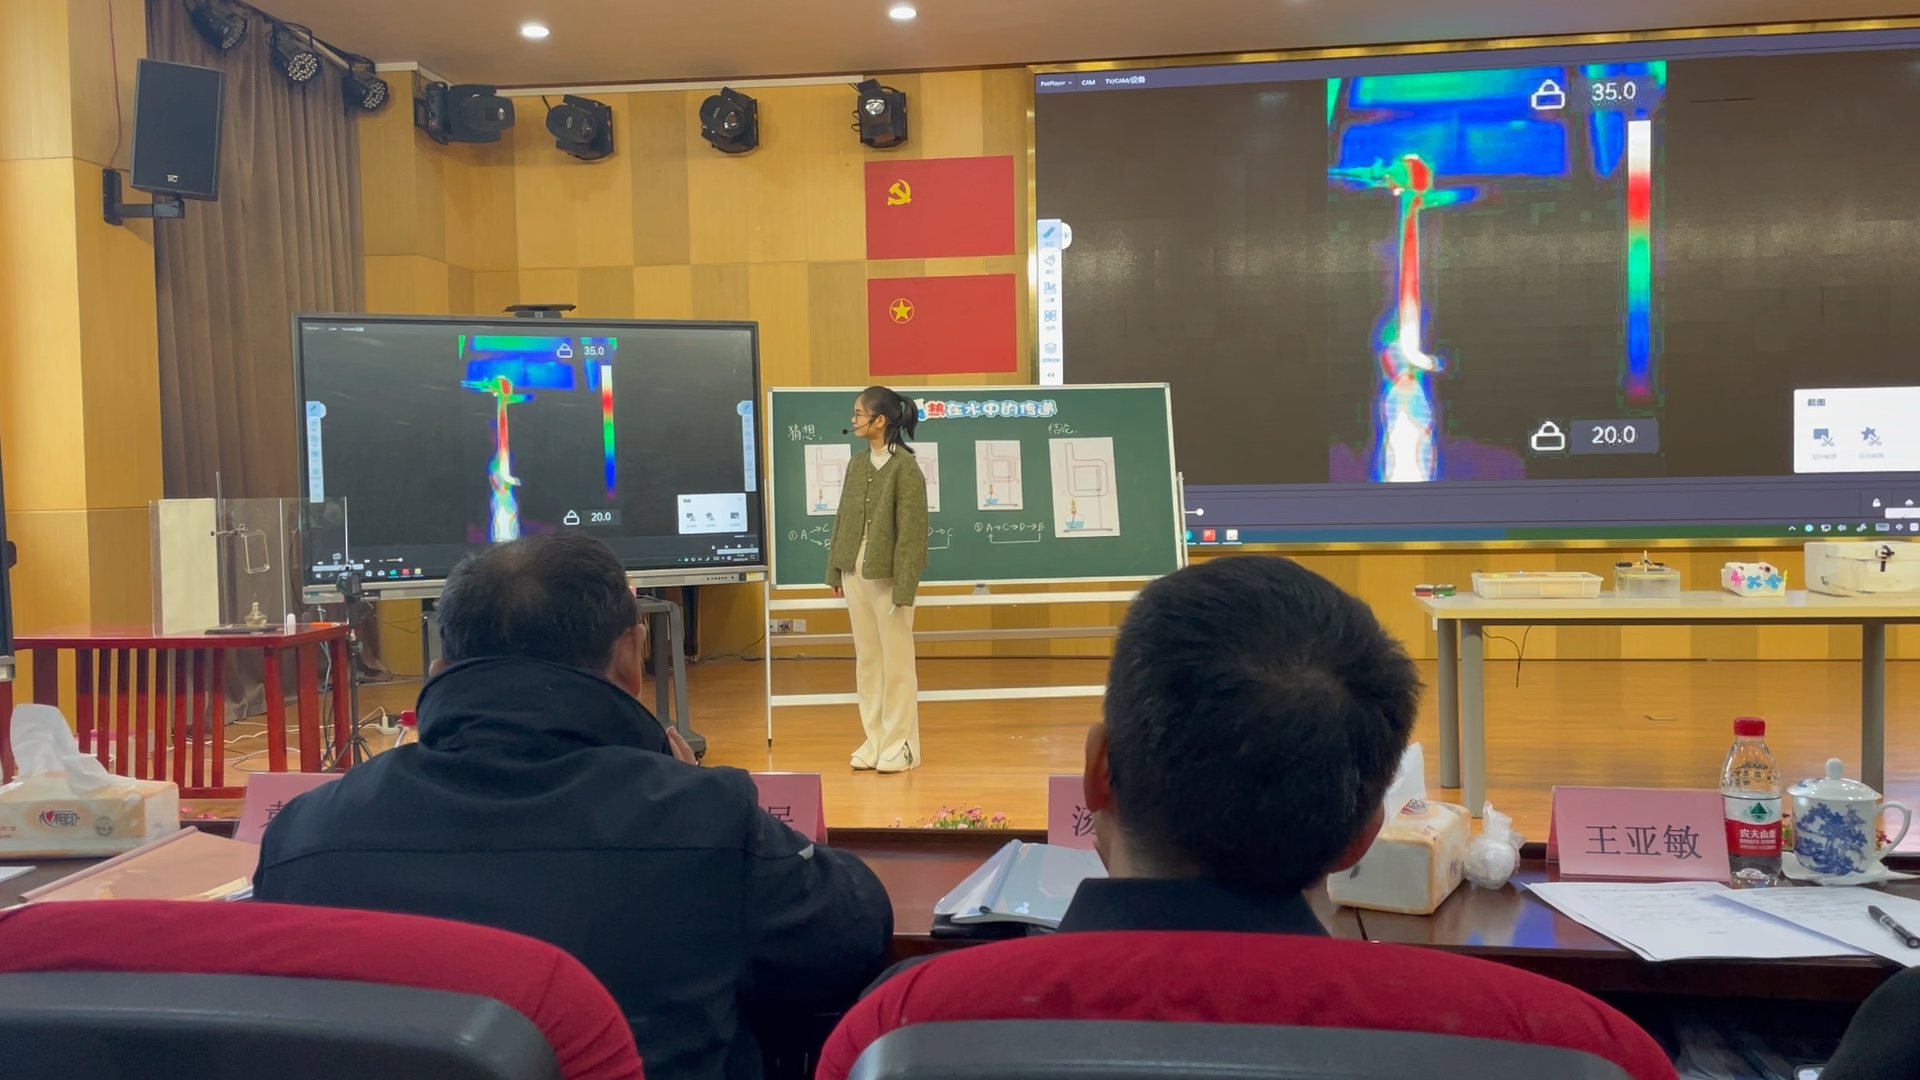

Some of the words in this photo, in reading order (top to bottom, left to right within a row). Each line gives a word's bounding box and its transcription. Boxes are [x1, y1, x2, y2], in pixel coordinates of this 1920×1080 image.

[1591, 81, 1636, 101] 35.0
[583, 346, 605, 356] 35.0
[926, 400, 1057, 418] 热在水中的传递
[1591, 425, 1636, 444] 20.0
[590, 512, 612, 523] 20.0
[1585, 824, 1703, 860] 王亚敏
